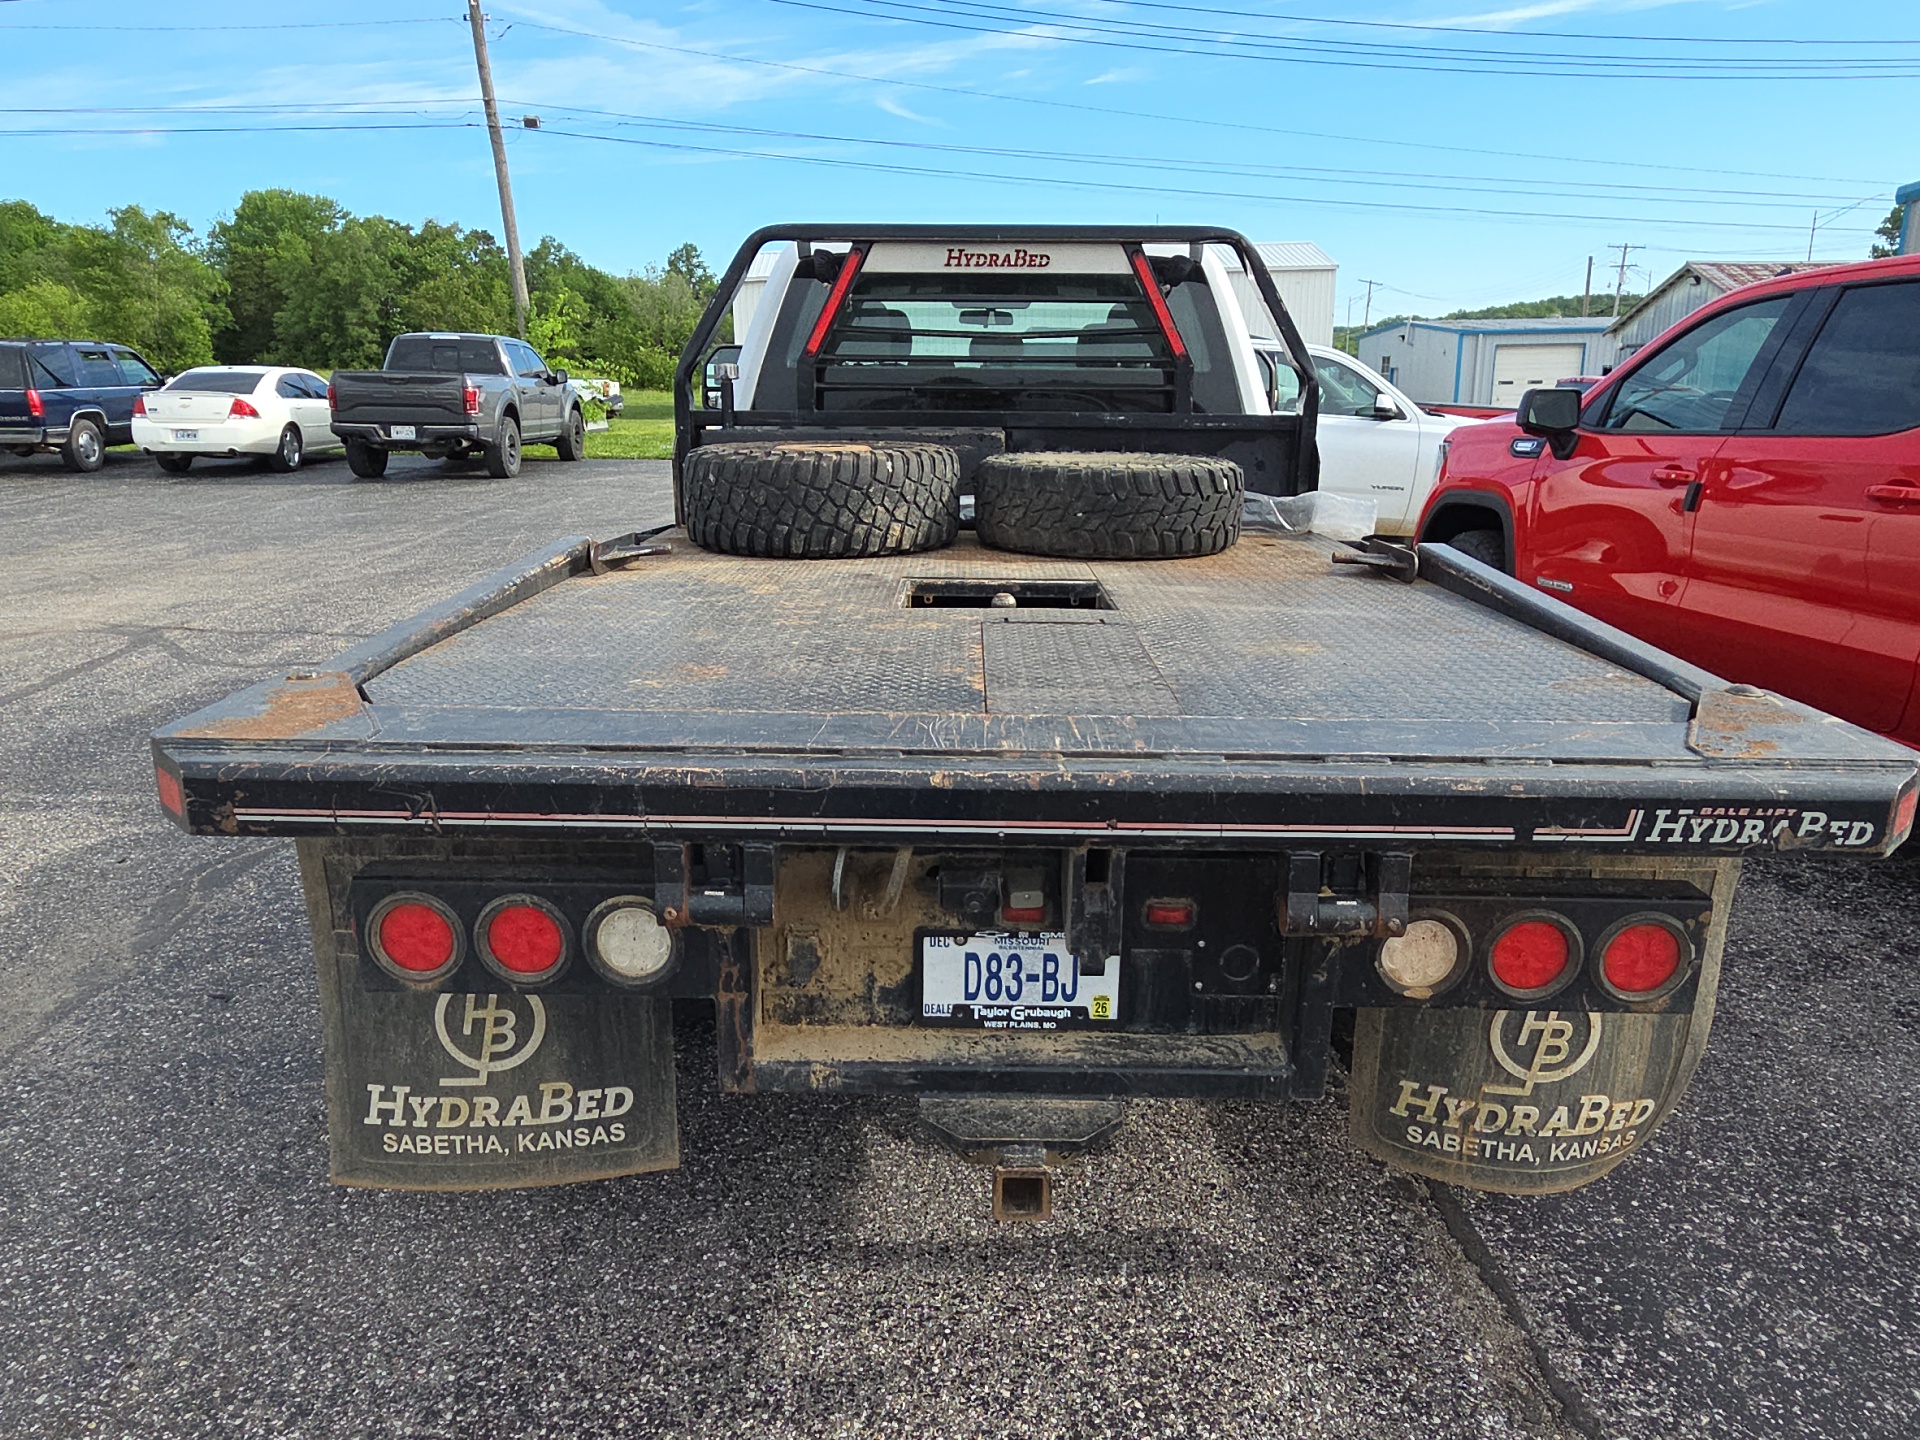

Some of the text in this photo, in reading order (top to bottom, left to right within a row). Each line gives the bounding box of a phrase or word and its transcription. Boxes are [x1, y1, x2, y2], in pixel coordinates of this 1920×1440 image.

[1701, 807, 1798, 817] BALE LIFT
[929, 936, 950, 947] DEC
[994, 937, 1050, 946] MISSOURI
[964, 951, 1079, 1003] D83-BJ
[924, 1003, 952, 1015] DEALE
[970, 1005, 1072, 1020] Taylor Grubaugh
[1095, 1001, 1107, 1013] 26
[984, 1020, 1057, 1029] WEST PLAINS, MO
[383, 1122, 626, 1156] SABETHA, KANSAS
[1406, 1126, 1637, 1166] SABETHA, KANSAS
